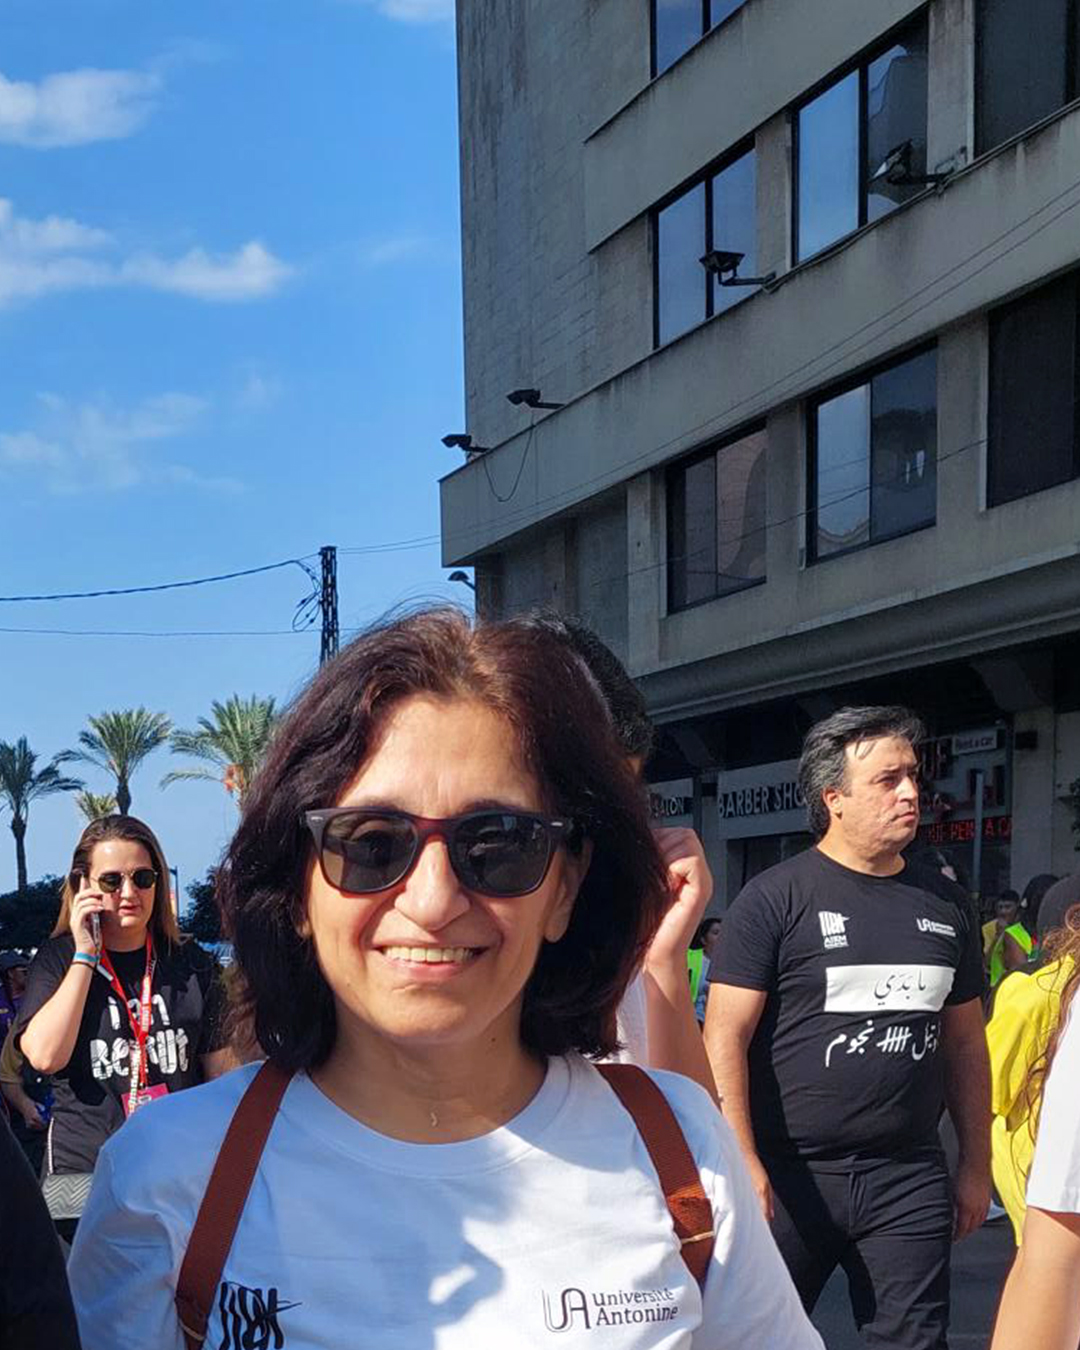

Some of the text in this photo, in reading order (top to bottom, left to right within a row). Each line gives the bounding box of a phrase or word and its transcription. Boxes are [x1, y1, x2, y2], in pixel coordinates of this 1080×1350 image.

[719, 781, 807, 819] BARBER SHO
[596, 1303, 679, 1326] Antonine
